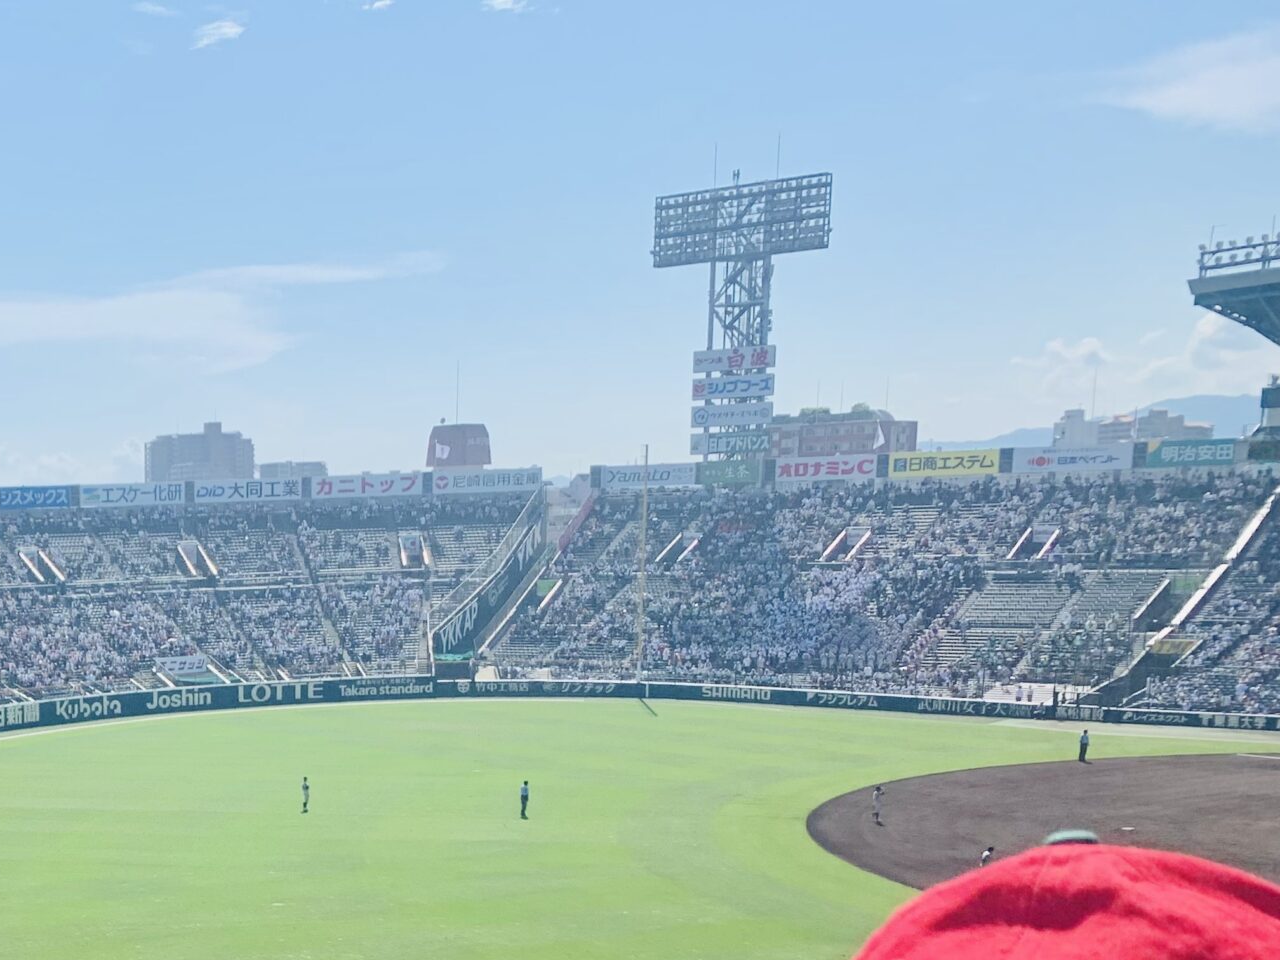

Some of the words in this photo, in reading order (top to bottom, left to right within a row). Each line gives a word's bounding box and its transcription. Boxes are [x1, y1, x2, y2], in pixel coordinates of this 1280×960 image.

[707, 378, 770, 395] シノブフーズ
[1161, 445, 1234, 462] 明治安田
[778, 459, 874, 478] オロナミンC
[909, 455, 995, 471] 日商エステム
[452, 472, 539, 489] 尼崎信用金庫
[607, 469, 670, 483] Yamato
[102, 484, 182, 503] エスケー化研
[228, 481, 299, 499] 大同工業
[316, 476, 418, 495] カニトップ
[1, 489, 67, 507] シスメックス
[238, 681, 325, 703] LOTTE
[339, 684, 377, 697] Takara
[379, 681, 433, 696] standard
[561, 682, 617, 694] リンテック
[702, 685, 771, 701] SHIMANO
[56, 695, 121, 720] Kubota
[146, 687, 212, 710] Joshin
[817, 690, 879, 708] フジプレアム
